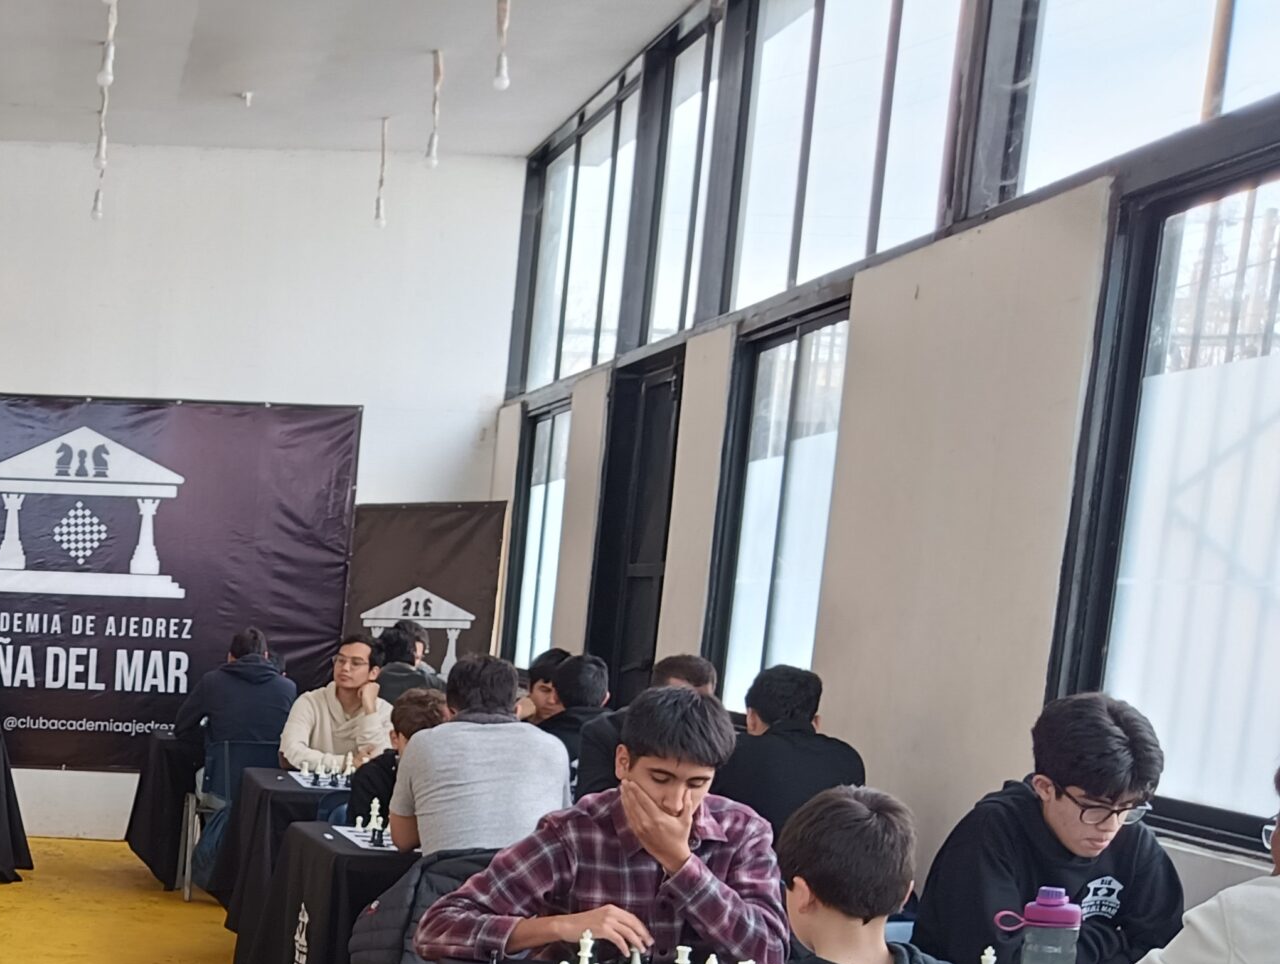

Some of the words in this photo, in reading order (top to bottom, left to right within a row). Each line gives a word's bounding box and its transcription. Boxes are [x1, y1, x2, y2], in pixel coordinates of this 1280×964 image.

[71, 615, 96, 635] DE
[105, 616, 193, 639] AJEDREZ
[45, 646, 105, 691] DEL
[114, 649, 189, 693] MAR
